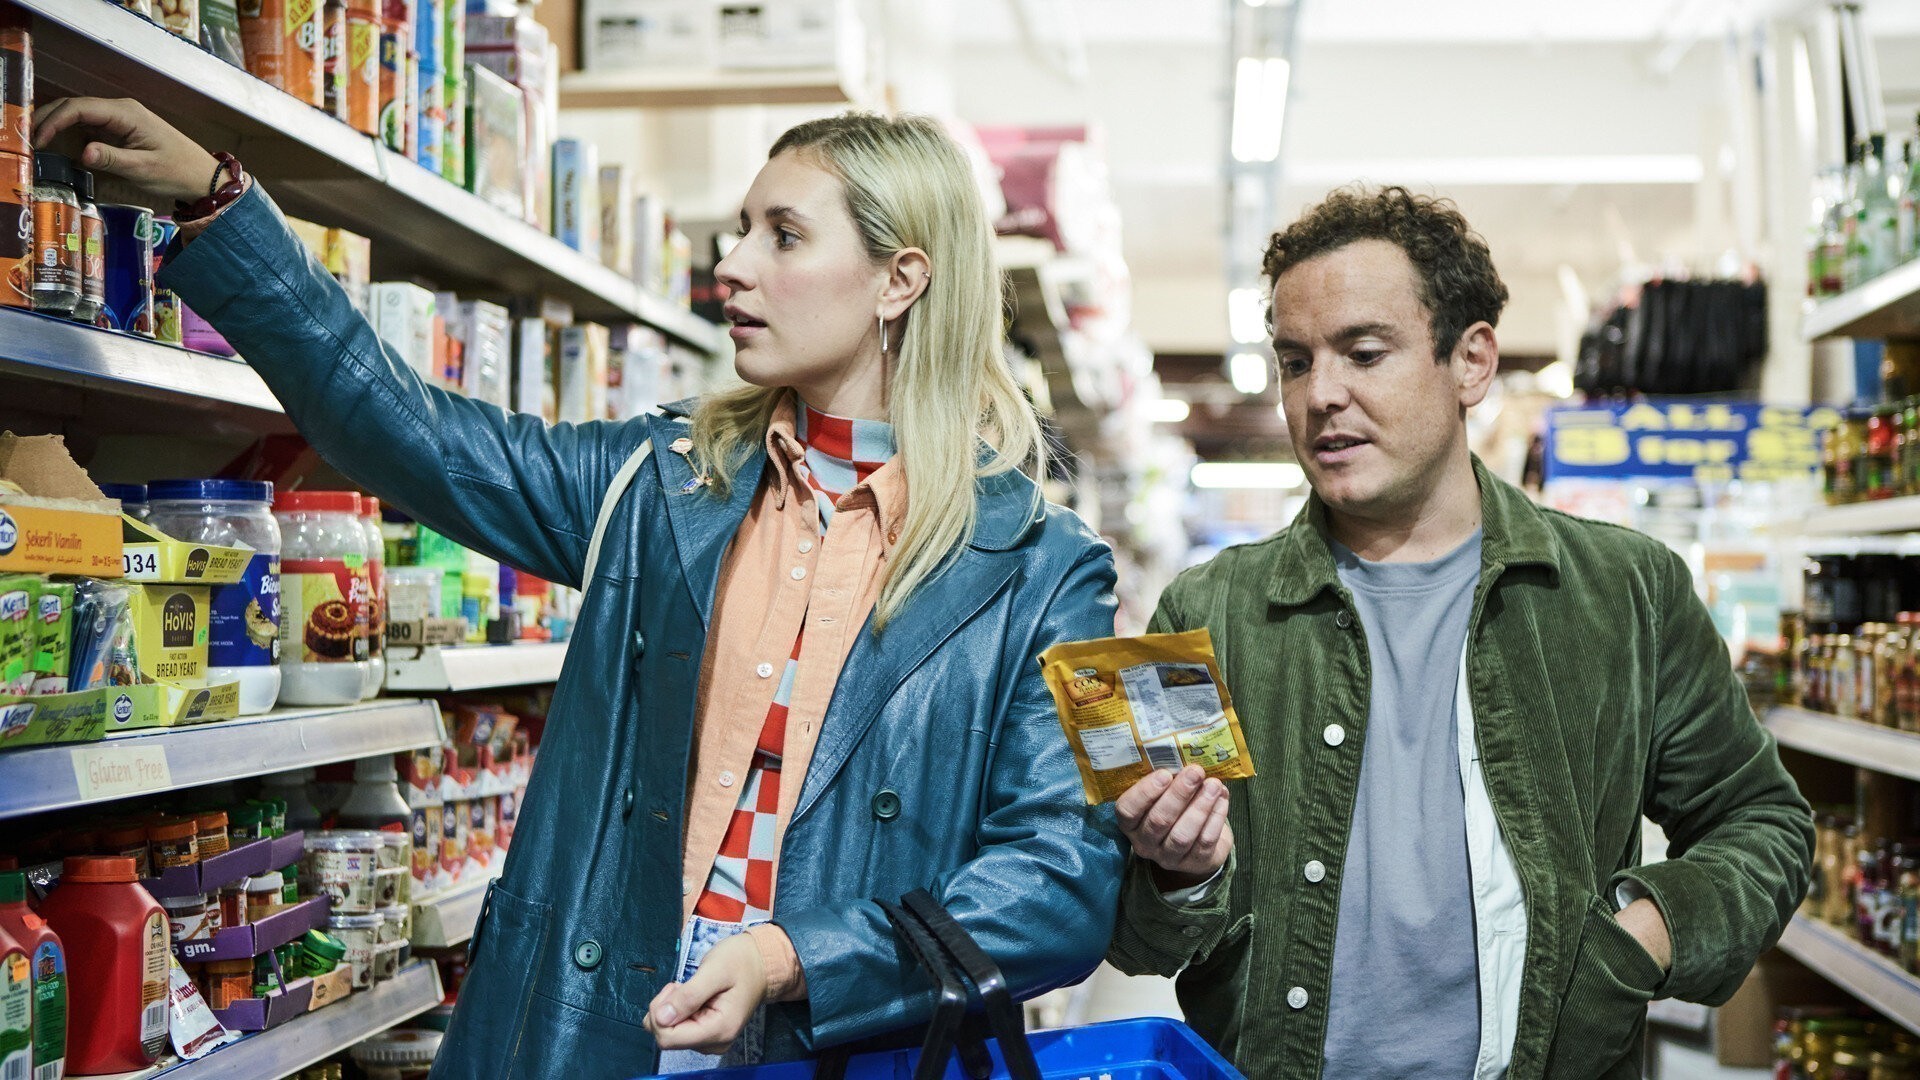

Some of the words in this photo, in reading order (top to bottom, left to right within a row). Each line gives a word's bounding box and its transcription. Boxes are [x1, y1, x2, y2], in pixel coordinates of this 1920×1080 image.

[209, 557, 228, 568] BREAD
[228, 558, 244, 569] YEAST
[156, 663, 178, 678] BREAD
[180, 662, 197, 676] YEAST
[88, 756, 133, 790] Gluten
[135, 758, 164, 787] Free
